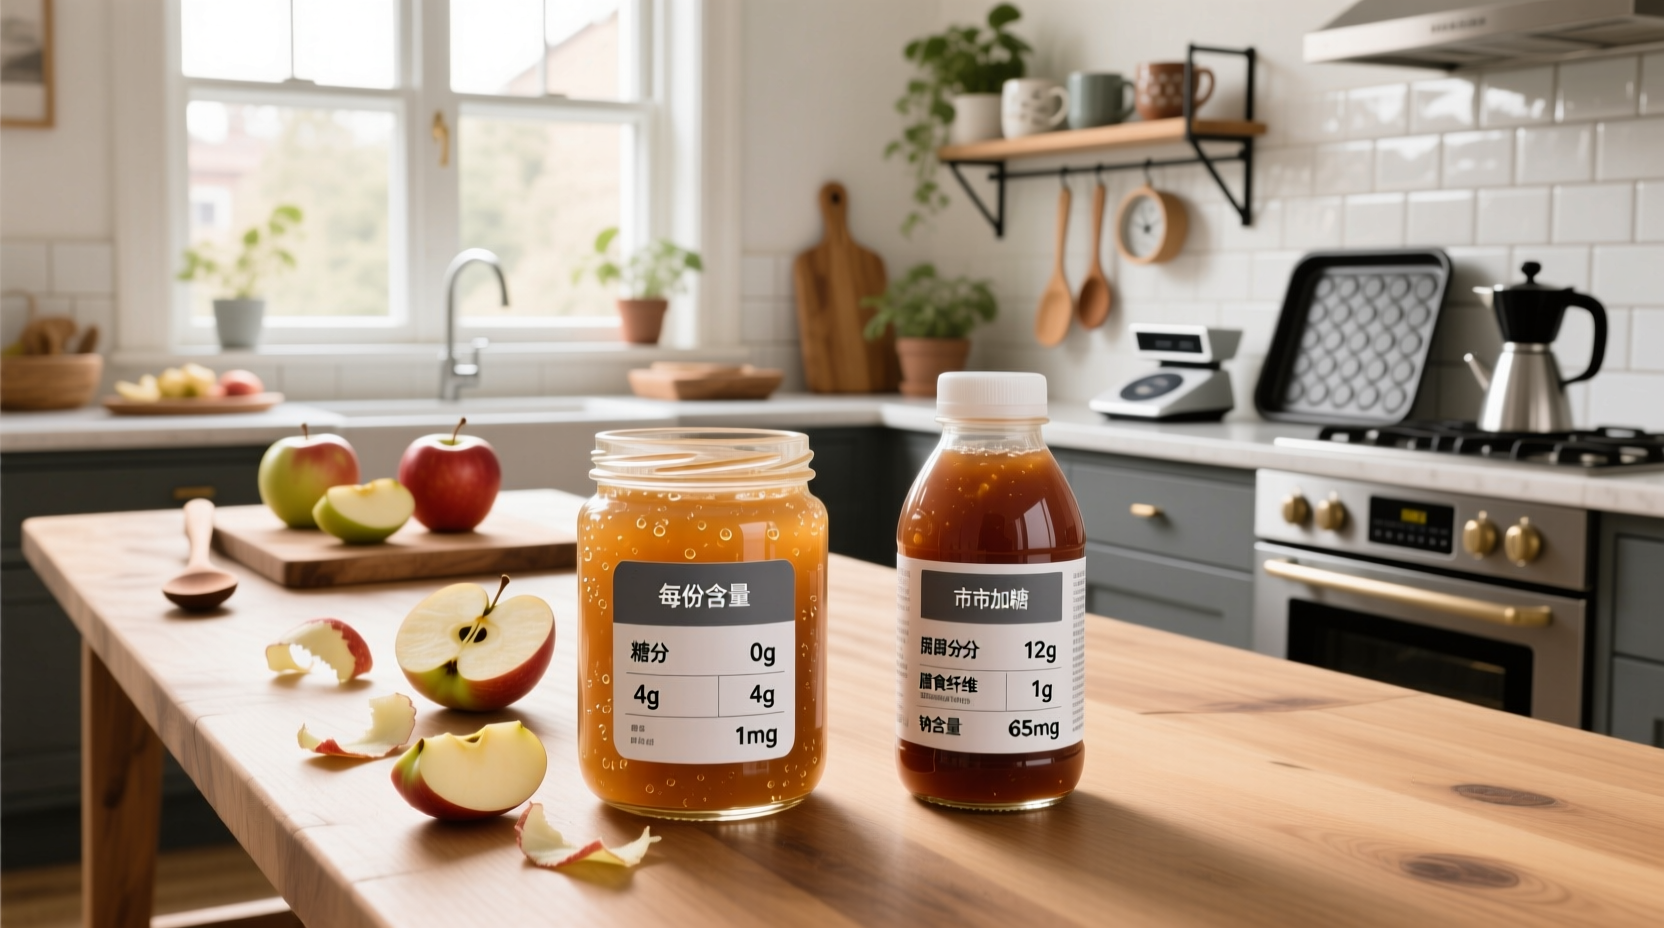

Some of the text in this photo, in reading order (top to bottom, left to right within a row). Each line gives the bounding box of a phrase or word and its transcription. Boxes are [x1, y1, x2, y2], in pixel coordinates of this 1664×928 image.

[658, 582, 751, 609] 每份含量
[630, 639, 669, 664] 糖分
[750, 642, 776, 667] 0g
[1024, 641, 1057, 664] 12g
[633, 684, 660, 710] 4g
[749, 684, 775, 708] 4g
[1032, 680, 1053, 703] 1g
[736, 726, 778, 748] 1mg
[1008, 719, 1060, 740] 65mg
